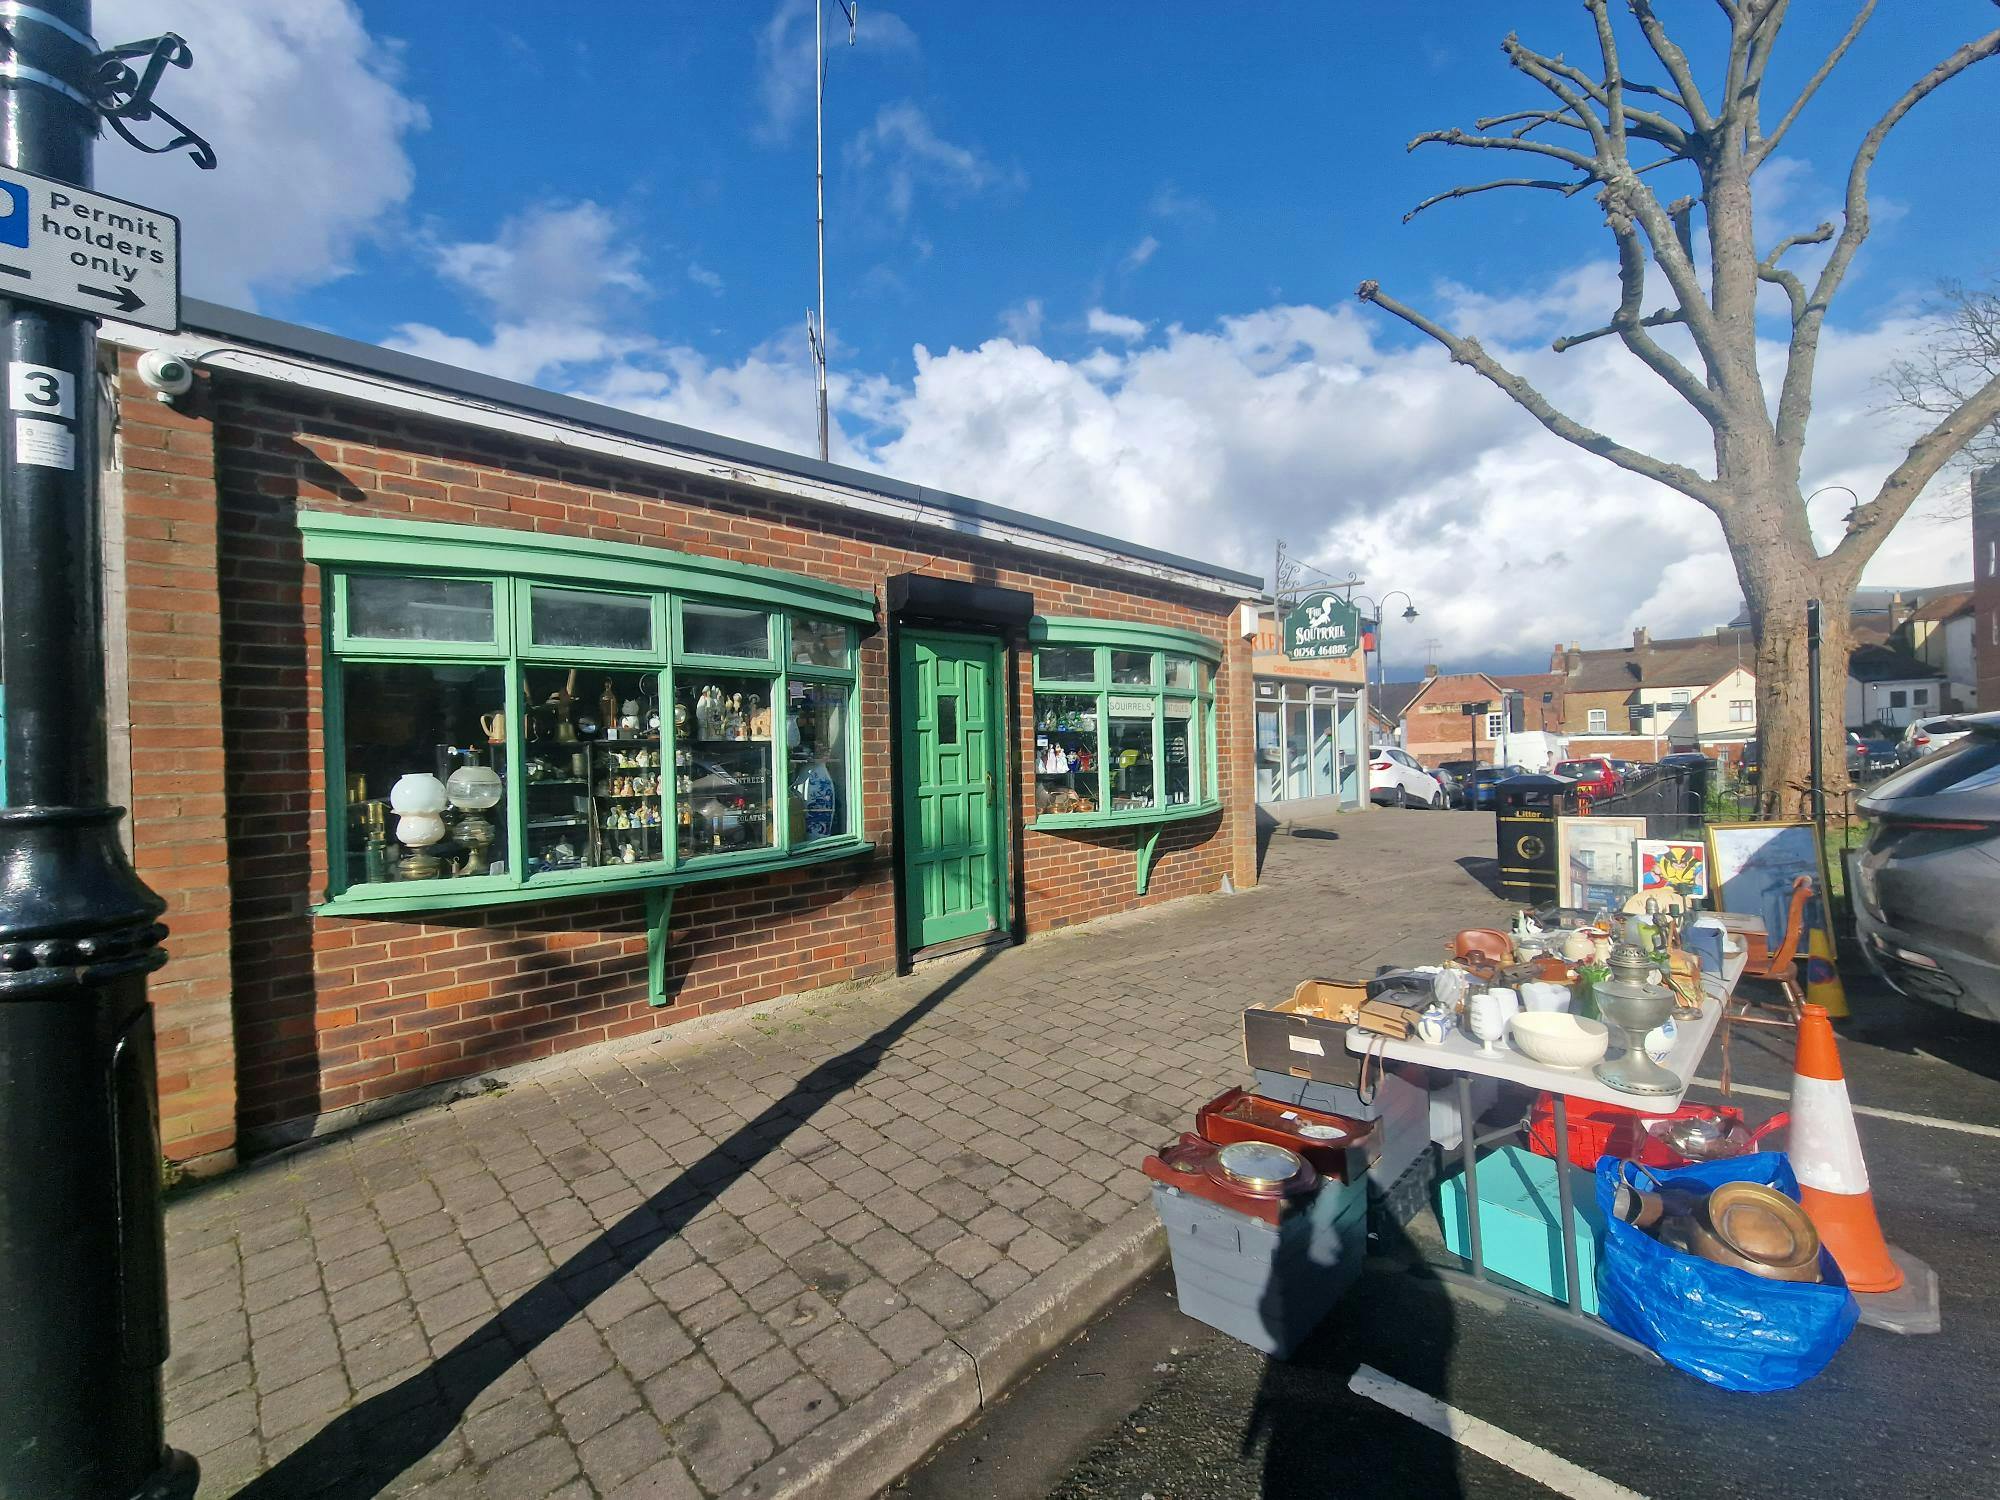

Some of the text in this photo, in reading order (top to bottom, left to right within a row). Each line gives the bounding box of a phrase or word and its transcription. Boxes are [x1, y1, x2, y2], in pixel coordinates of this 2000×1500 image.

[50, 191, 159, 240] Permit
[43, 213, 164, 264] holders
[70, 251, 138, 282] only
[24, 371, 60, 407] 3
[1109, 702, 1152, 711] SQUIRRELS
[1516, 810, 1541, 818] Litter
